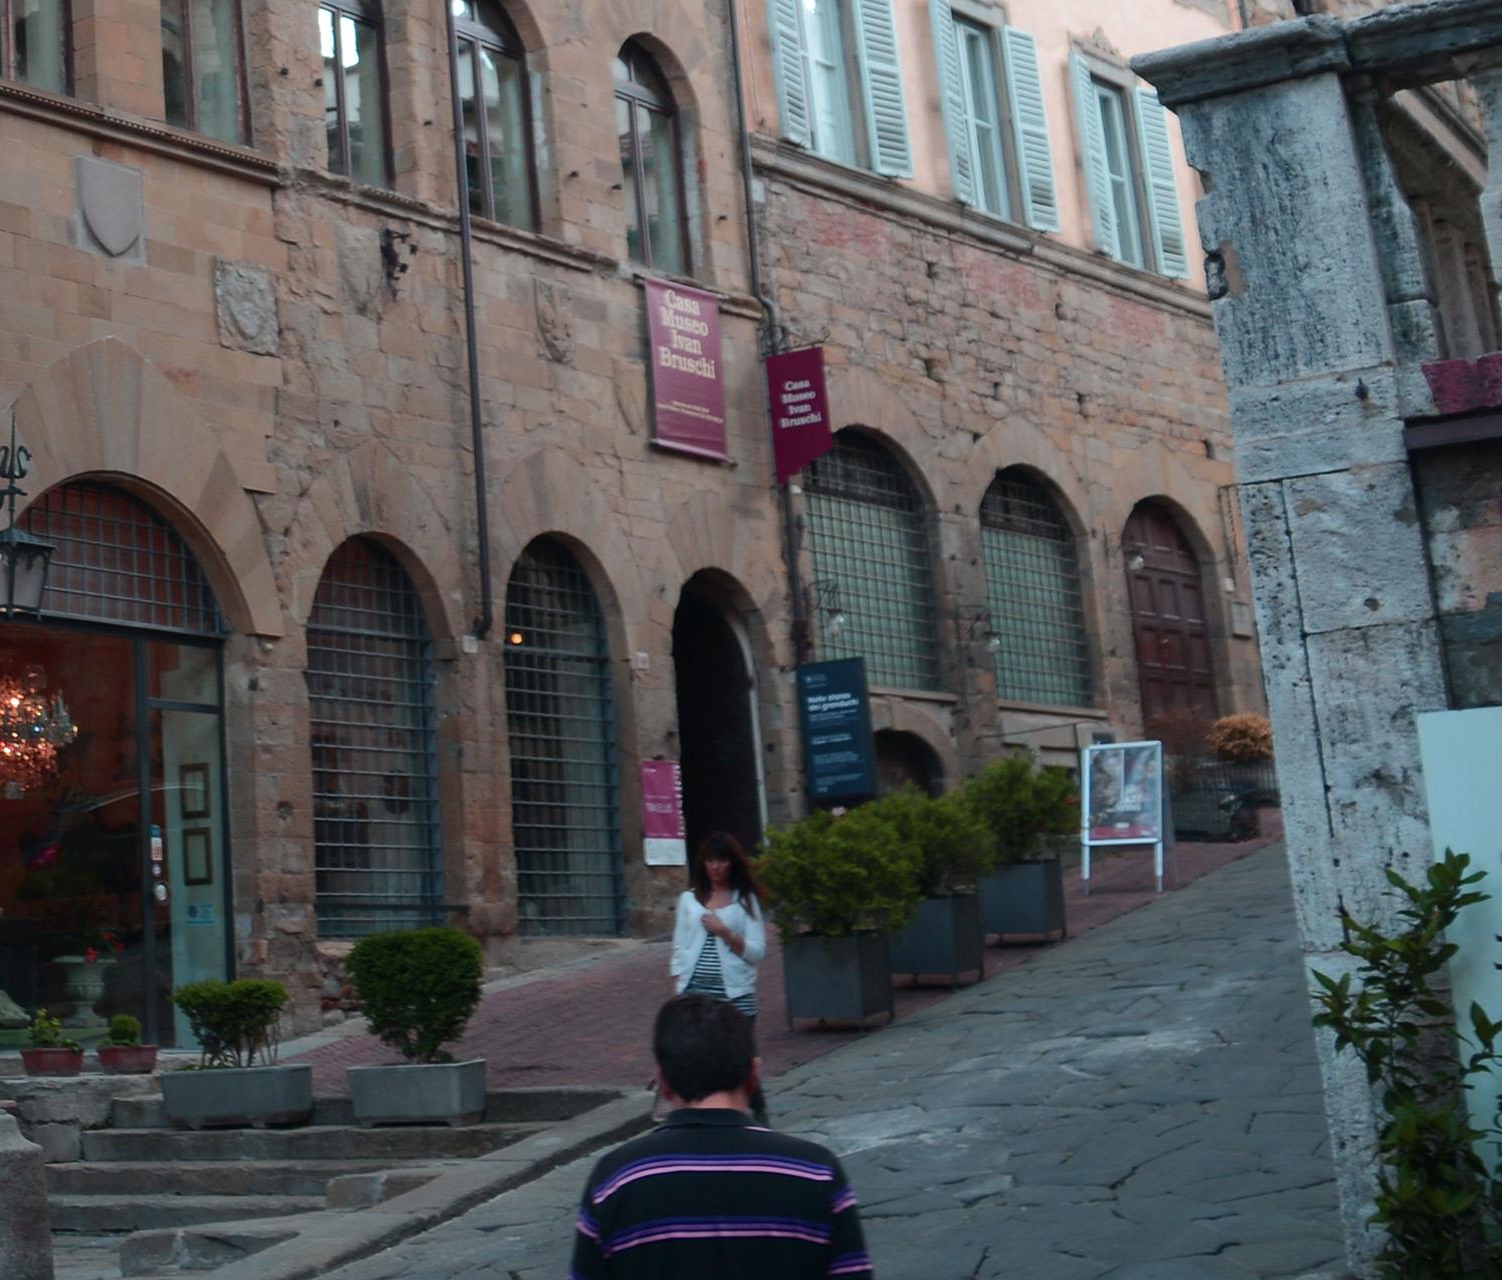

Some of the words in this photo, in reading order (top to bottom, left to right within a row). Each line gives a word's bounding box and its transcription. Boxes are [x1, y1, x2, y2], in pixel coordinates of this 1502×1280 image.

[664, 289, 701, 316] Casa
[659, 306, 709, 337] Museo
[671, 329, 703, 355] Ivan
[659, 345, 716, 380] Bruschi
[785, 380, 810, 391] Casa
[782, 391, 816, 404] Museo
[781, 411, 822, 429] Bruschi
[789, 404, 812, 415] Ivan
